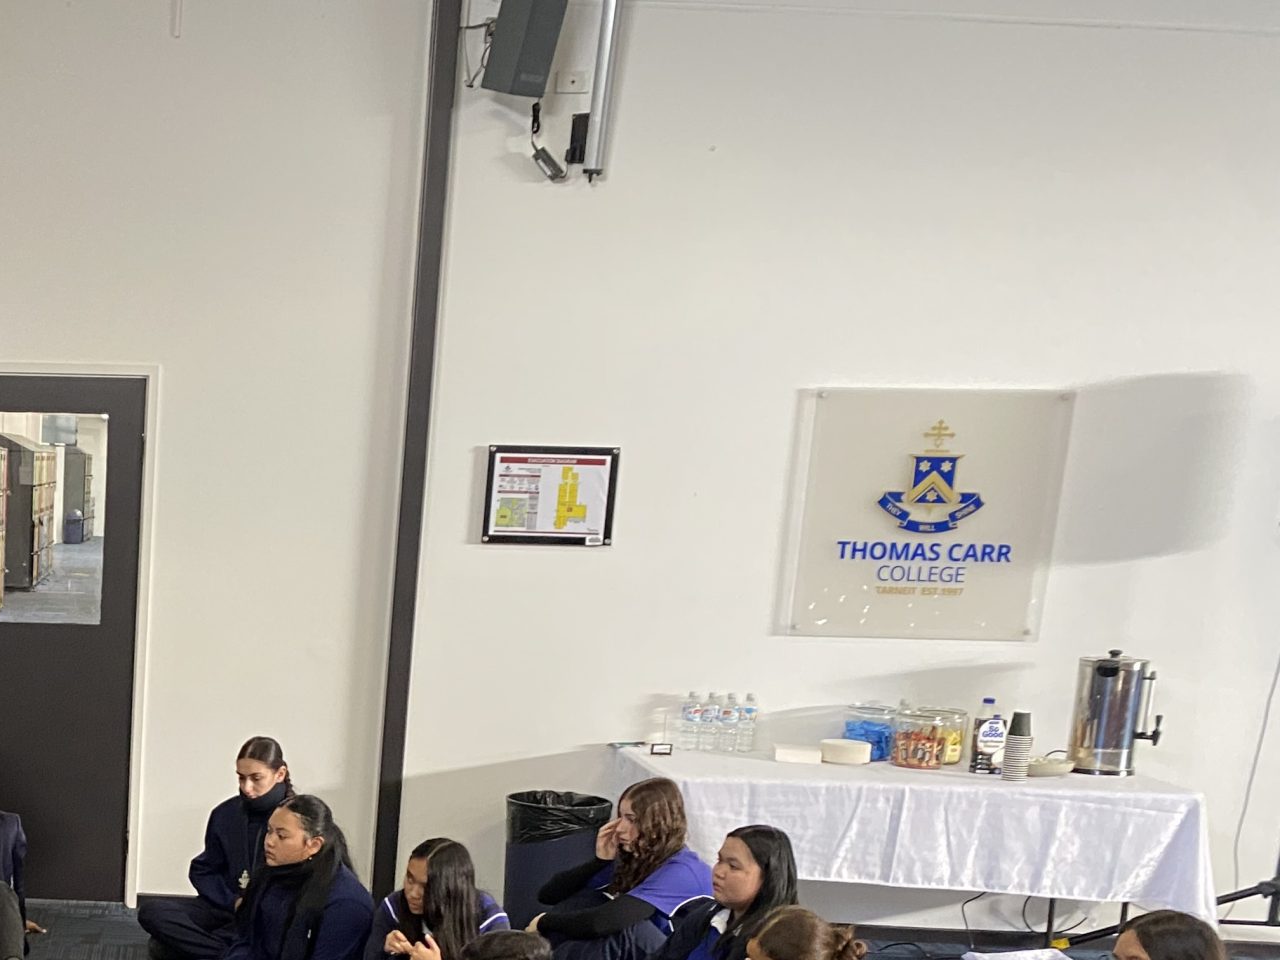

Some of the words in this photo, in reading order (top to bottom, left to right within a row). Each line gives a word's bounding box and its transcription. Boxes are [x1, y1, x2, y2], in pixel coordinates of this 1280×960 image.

[837, 541, 941, 562] THOMAS
[948, 543, 1012, 563] CARR
[876, 565, 967, 583] COLLEGE
